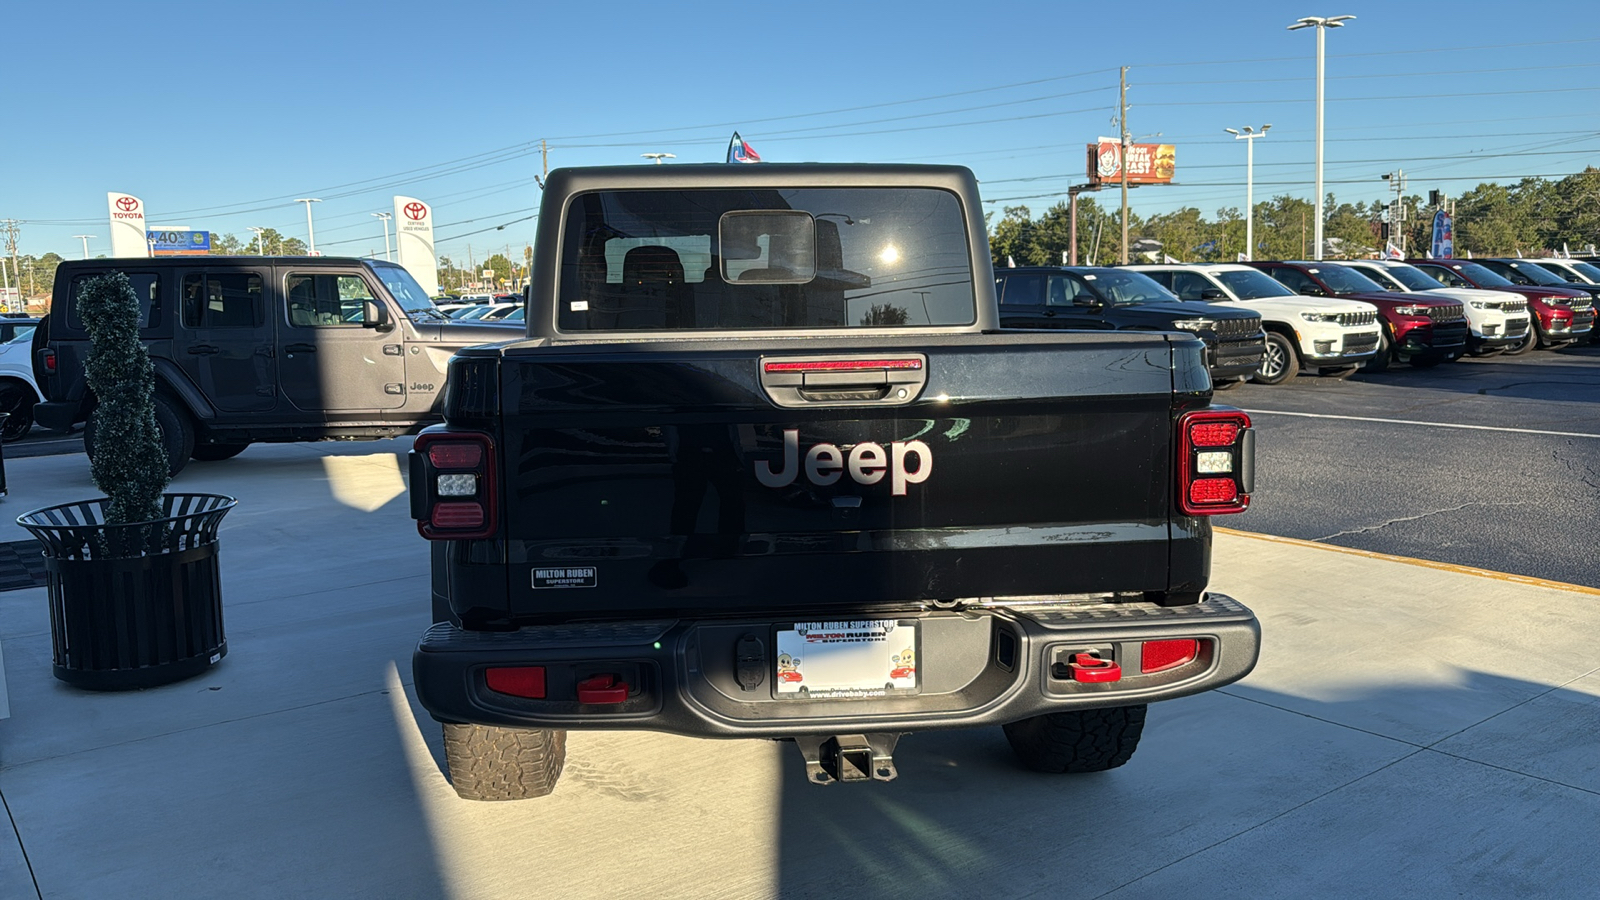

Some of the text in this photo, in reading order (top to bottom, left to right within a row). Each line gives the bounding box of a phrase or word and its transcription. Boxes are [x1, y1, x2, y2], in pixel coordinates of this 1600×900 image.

[1125, 162, 1151, 174] FAST
[410, 382, 434, 391] Jeep
[754, 428, 933, 496] Jeep
[535, 568, 594, 579] MILTON RUBEN
[794, 619, 898, 631] MILTON RUBEN SUPERSTORE
